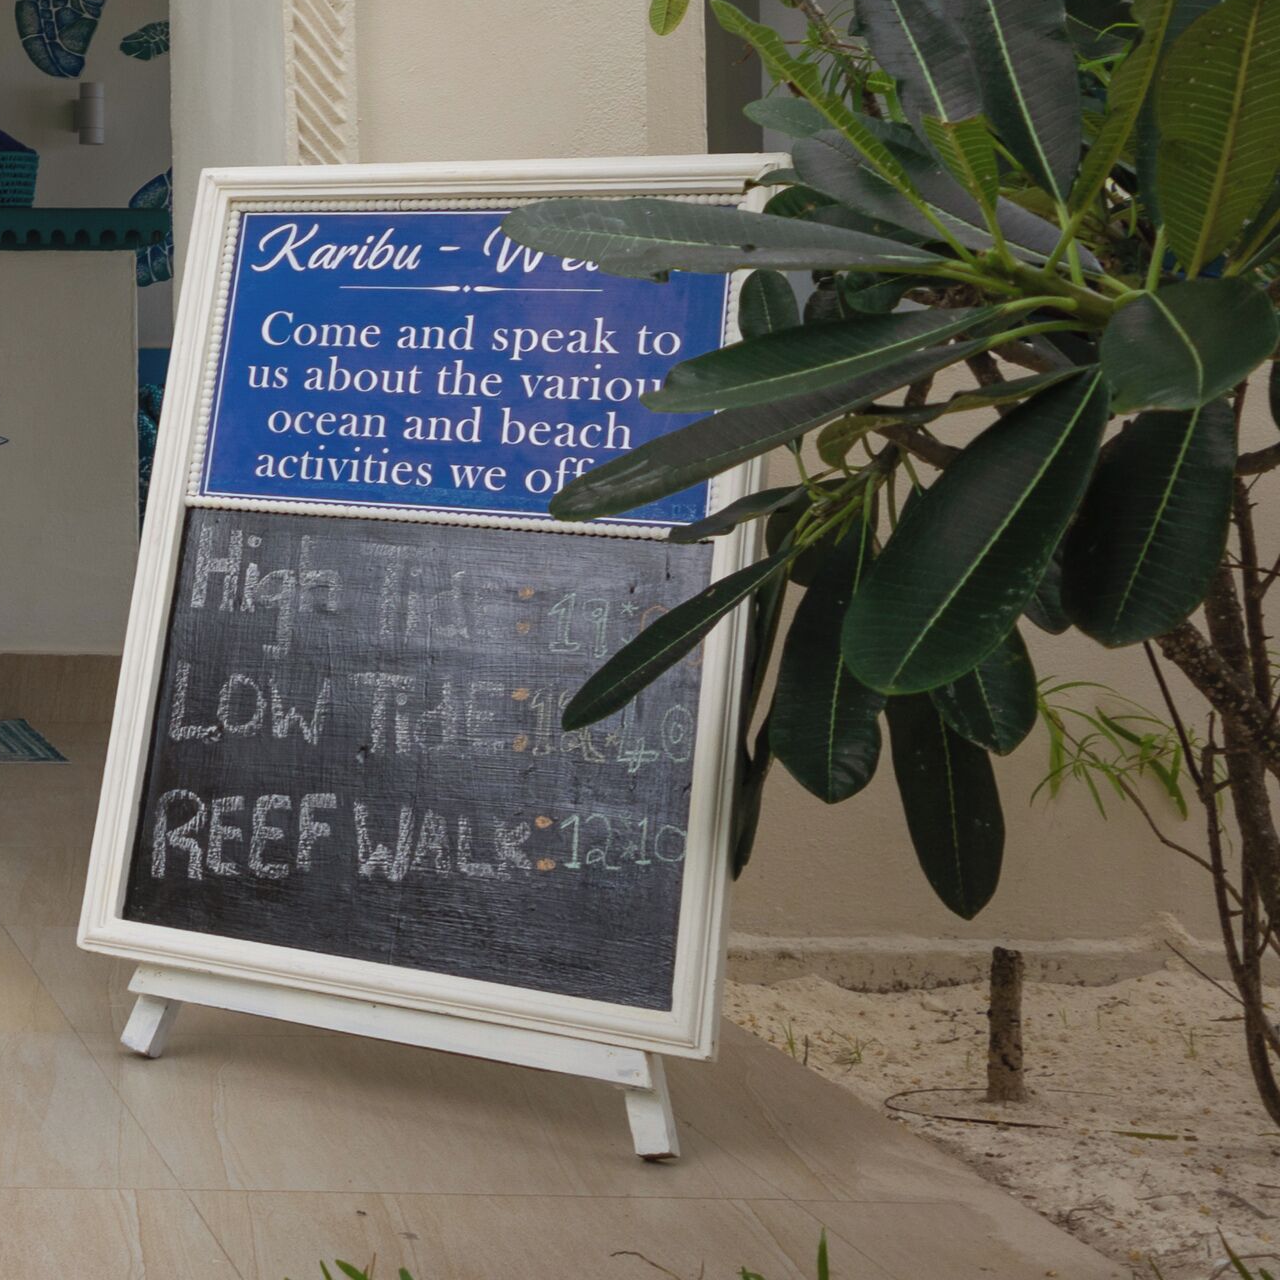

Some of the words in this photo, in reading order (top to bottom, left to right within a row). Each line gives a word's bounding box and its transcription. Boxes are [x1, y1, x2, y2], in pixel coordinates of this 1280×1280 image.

[251, 224, 421, 271] Karibu
[262, 311, 380, 348] Come
[397, 315, 474, 350] and
[492, 317, 619, 360] speak
[638, 326, 680, 355] to
[249, 366, 288, 388] us
[304, 356, 422, 394] about
[438, 360, 502, 396] the
[268, 411, 386, 437] ocean
[404, 406, 481, 442] and
[502, 408, 632, 449] beach
[255, 445, 432, 486] activities
[450, 465, 506, 490] we
[190, 523, 341, 658] High
[151, 788, 337, 881] REEF
